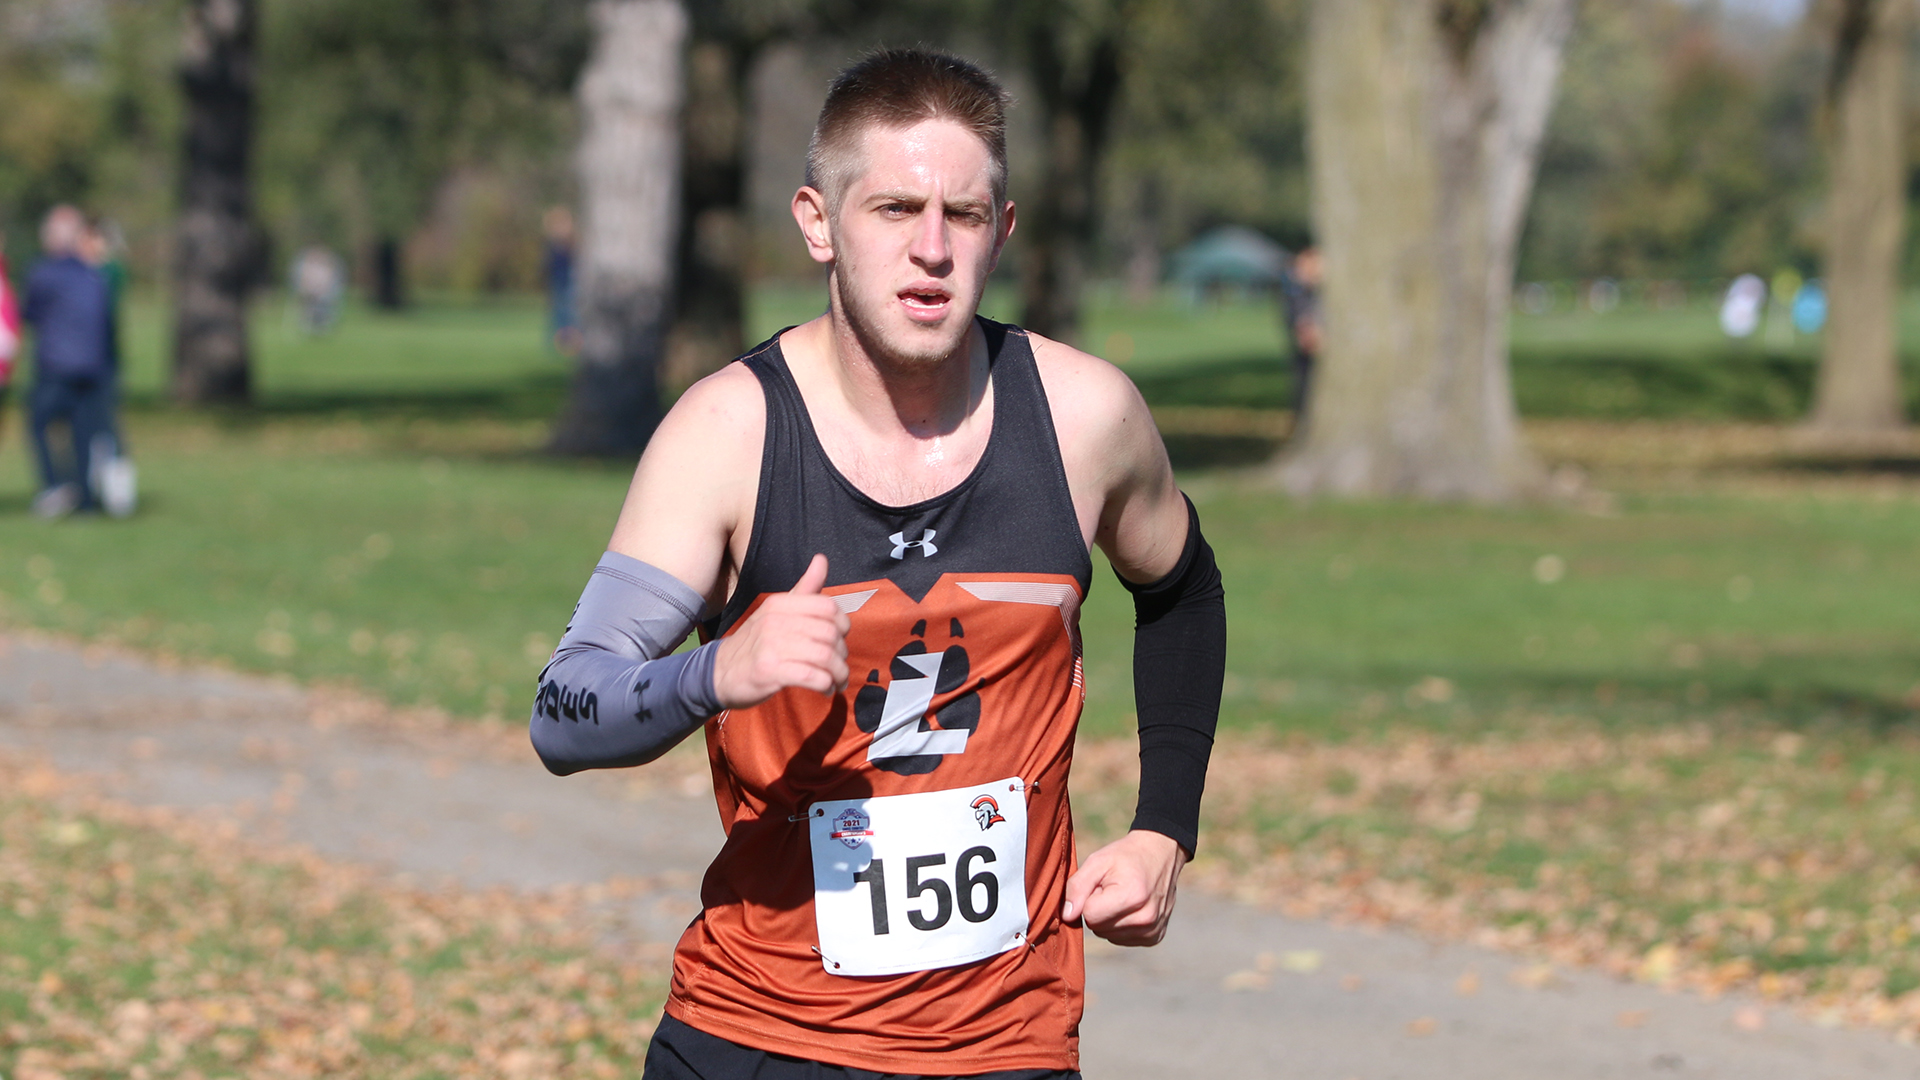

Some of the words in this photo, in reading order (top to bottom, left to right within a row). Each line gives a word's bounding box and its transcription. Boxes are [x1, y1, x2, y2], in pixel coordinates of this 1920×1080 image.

[866, 651, 970, 761] L
[842, 819, 860, 827] 2021
[853, 845, 999, 936] 156
